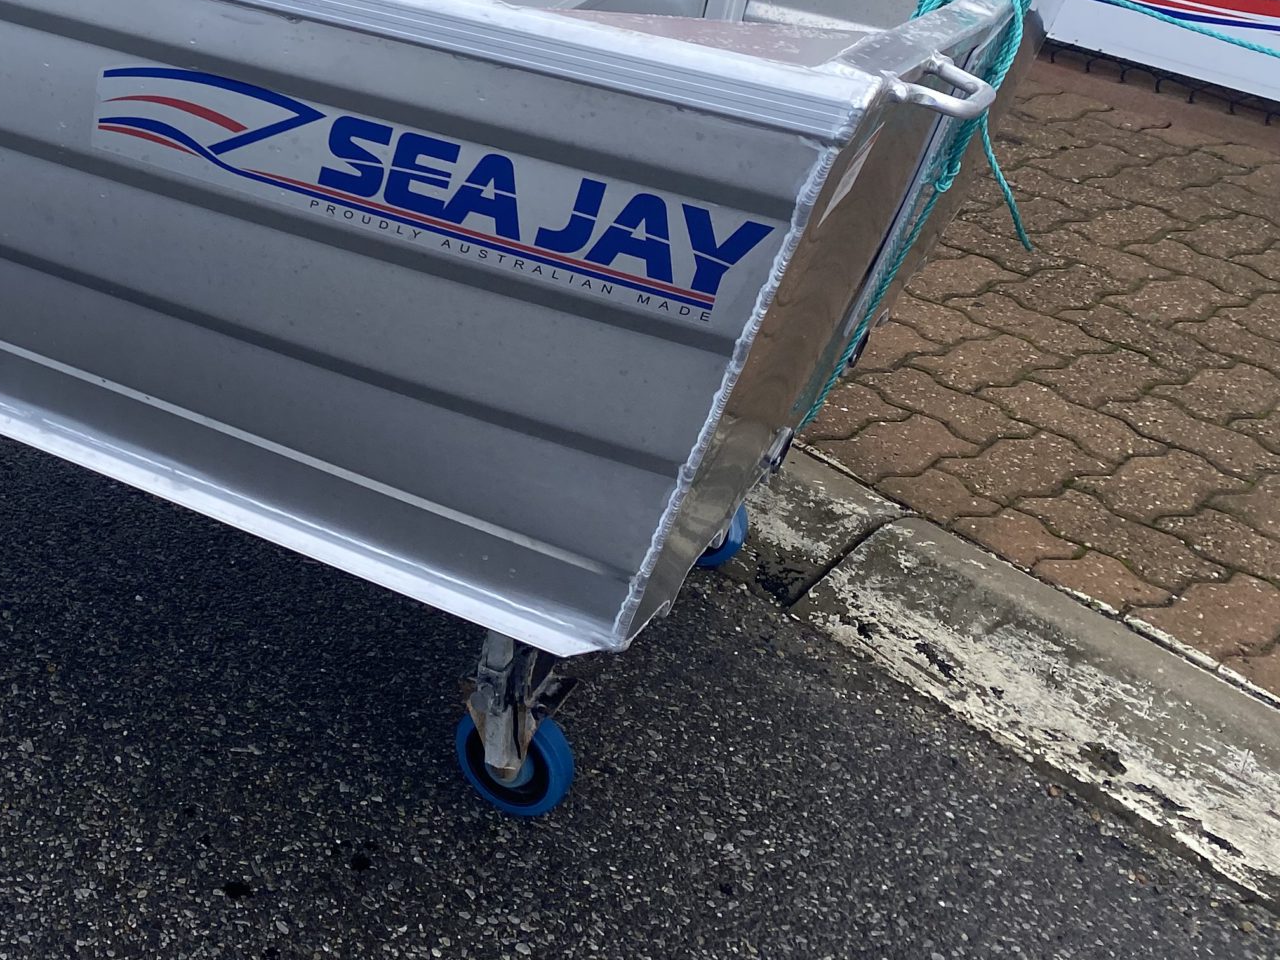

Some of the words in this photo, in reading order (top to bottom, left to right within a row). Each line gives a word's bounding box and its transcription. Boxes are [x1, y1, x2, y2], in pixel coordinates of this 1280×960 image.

[309, 199, 423, 240] PROUDLY
[440, 238, 614, 295] AUSTRALIAN
[636, 293, 713, 322] MADE
[317, 115, 521, 242] SEA
[533, 177, 776, 296] JAY
